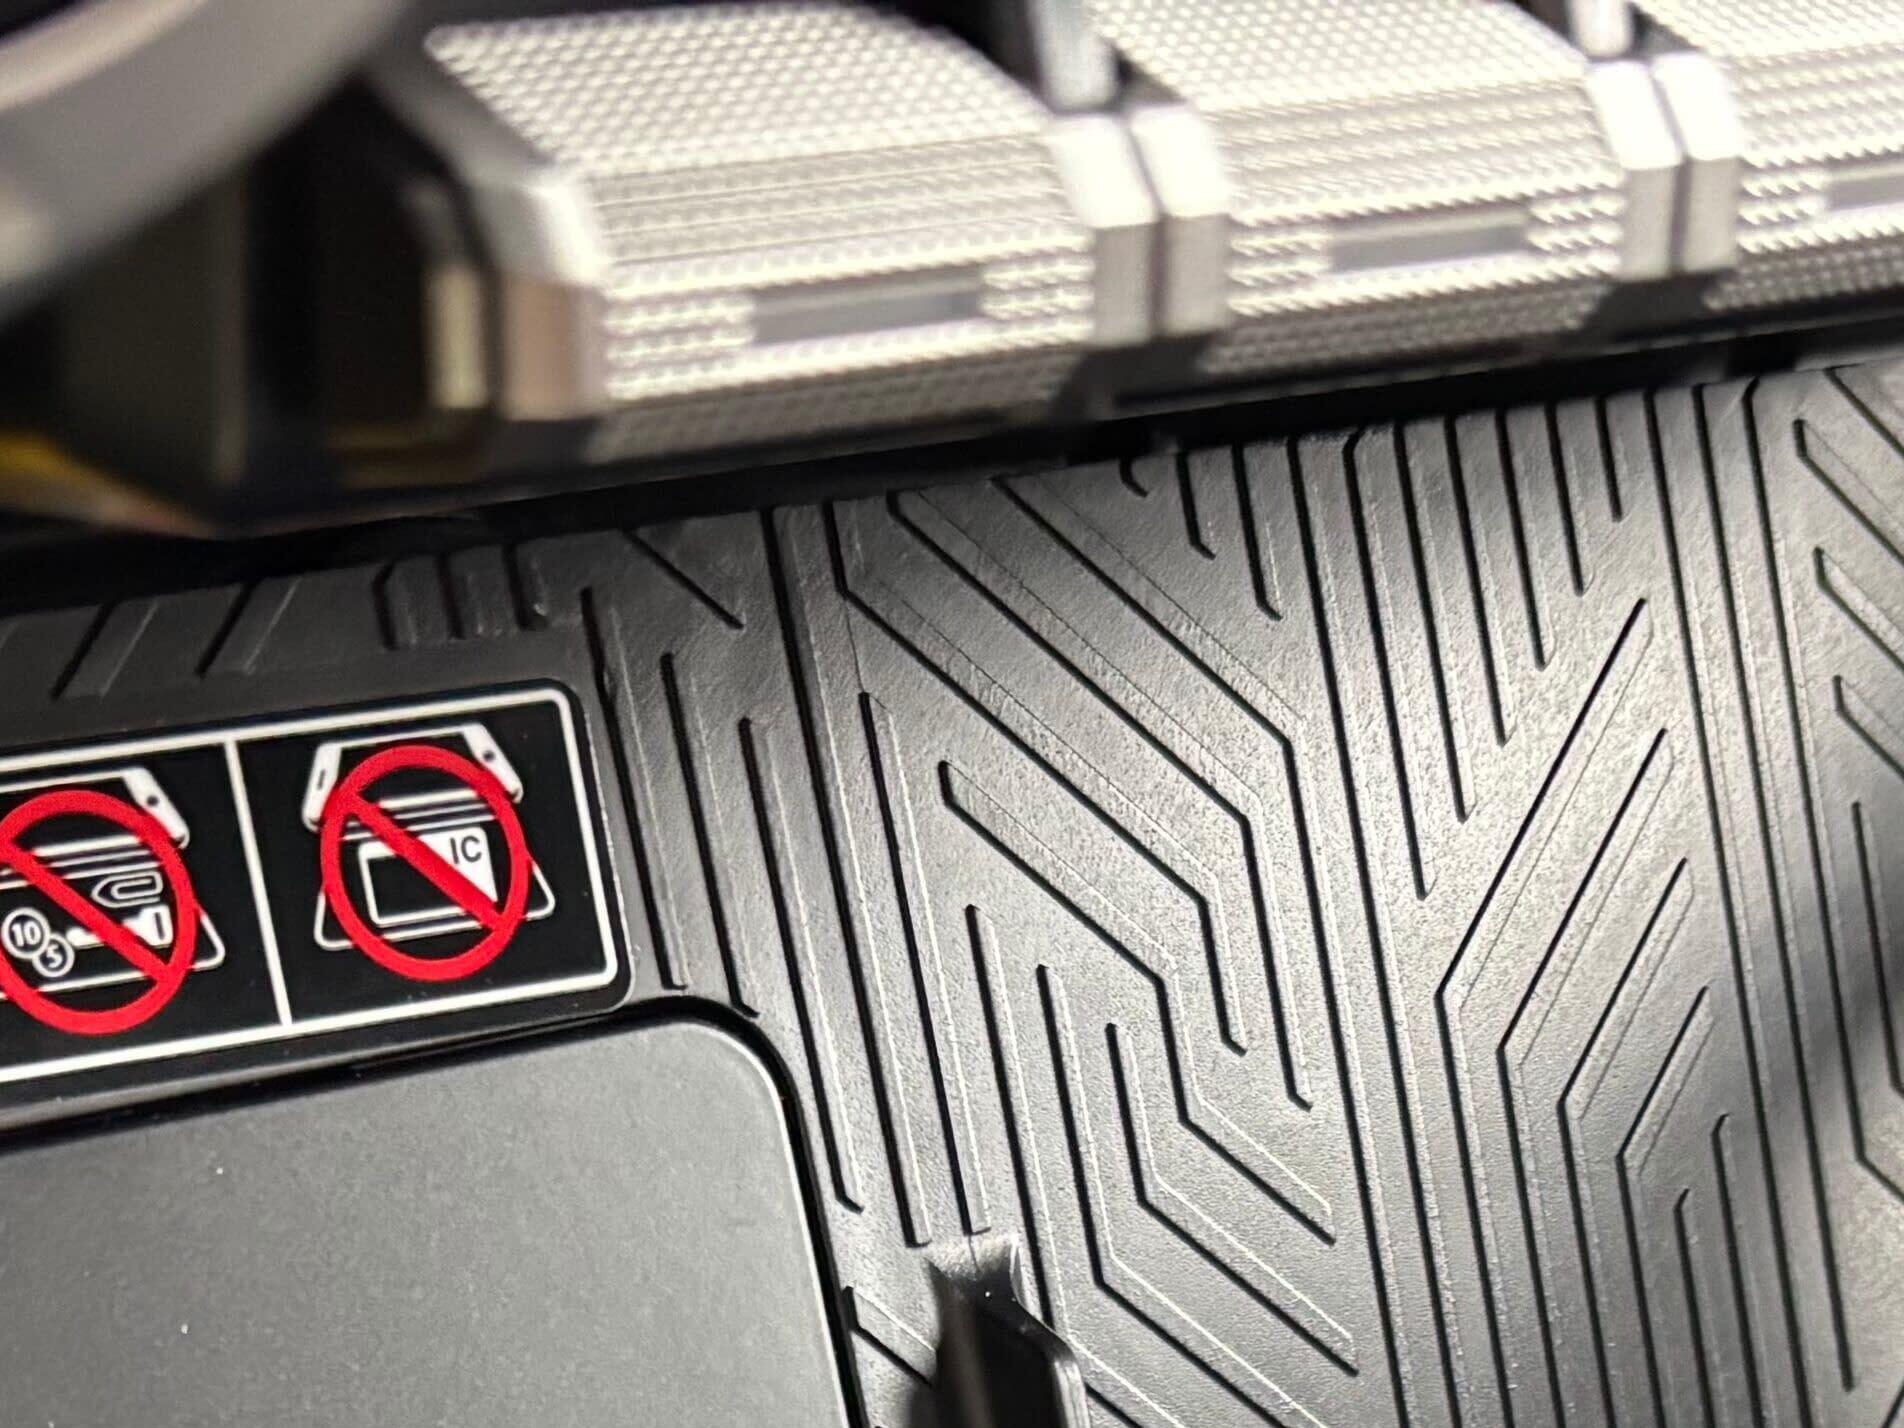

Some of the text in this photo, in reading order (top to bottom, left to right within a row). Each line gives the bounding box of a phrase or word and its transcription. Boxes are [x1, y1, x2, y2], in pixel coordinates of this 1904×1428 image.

[450, 835, 482, 864] IC
[11, 920, 42, 947] 10
[44, 944, 63, 968] 5
